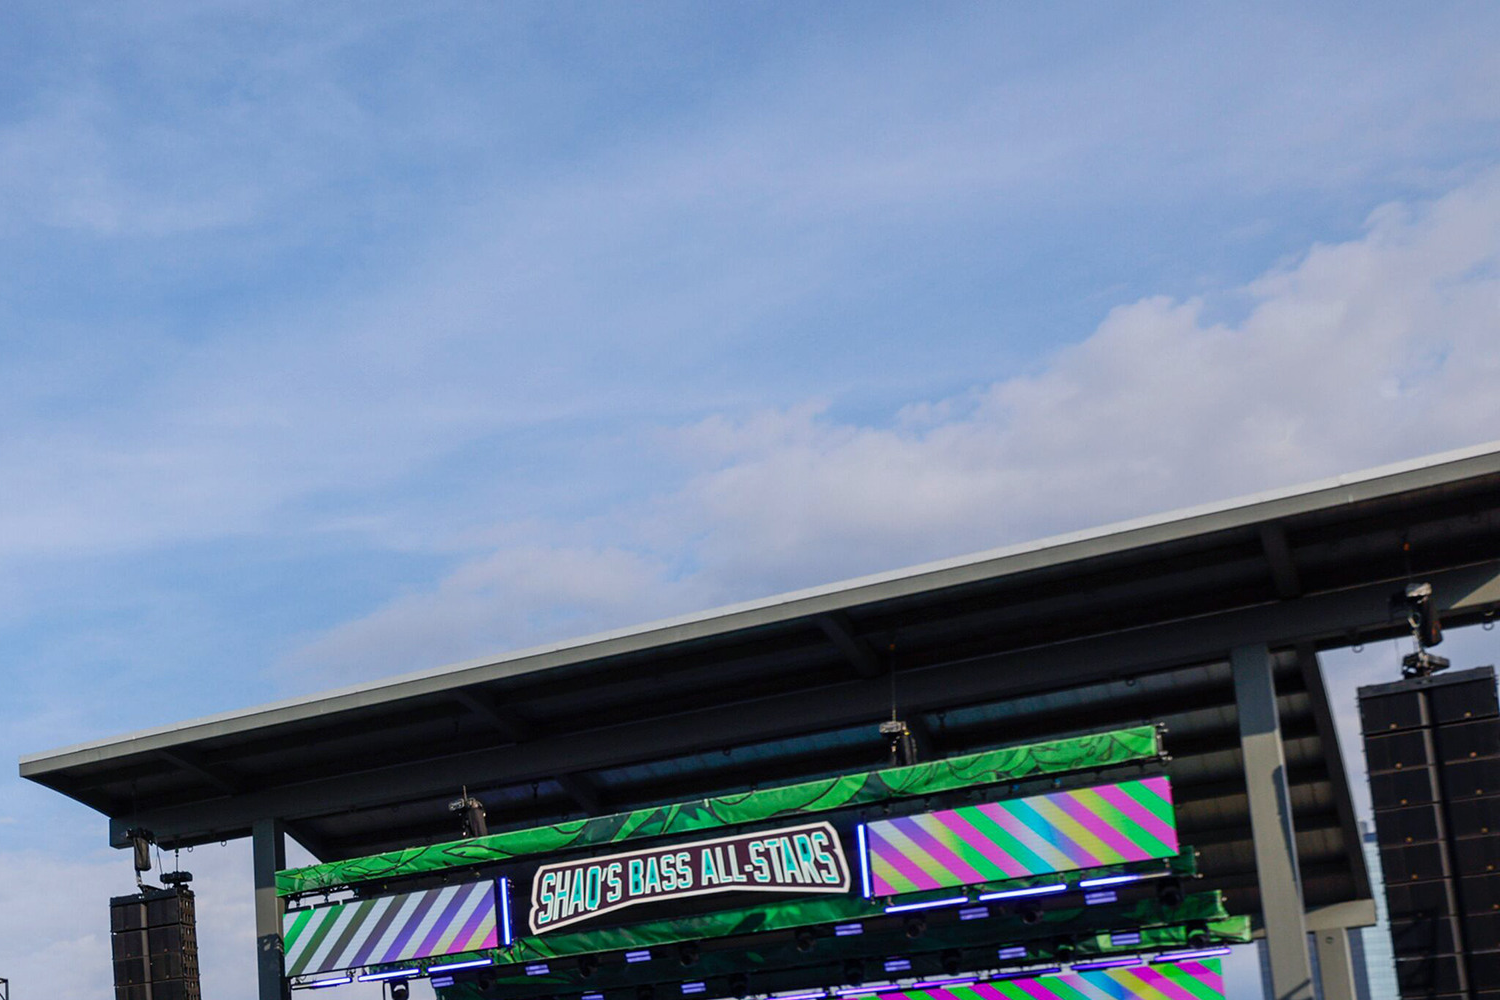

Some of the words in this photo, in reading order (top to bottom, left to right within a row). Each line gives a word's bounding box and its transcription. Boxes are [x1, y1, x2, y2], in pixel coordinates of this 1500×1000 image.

[538, 862, 623, 924] SHAQ'S
[628, 851, 692, 897] BASS
[700, 830, 841, 887] ALL-STARS
